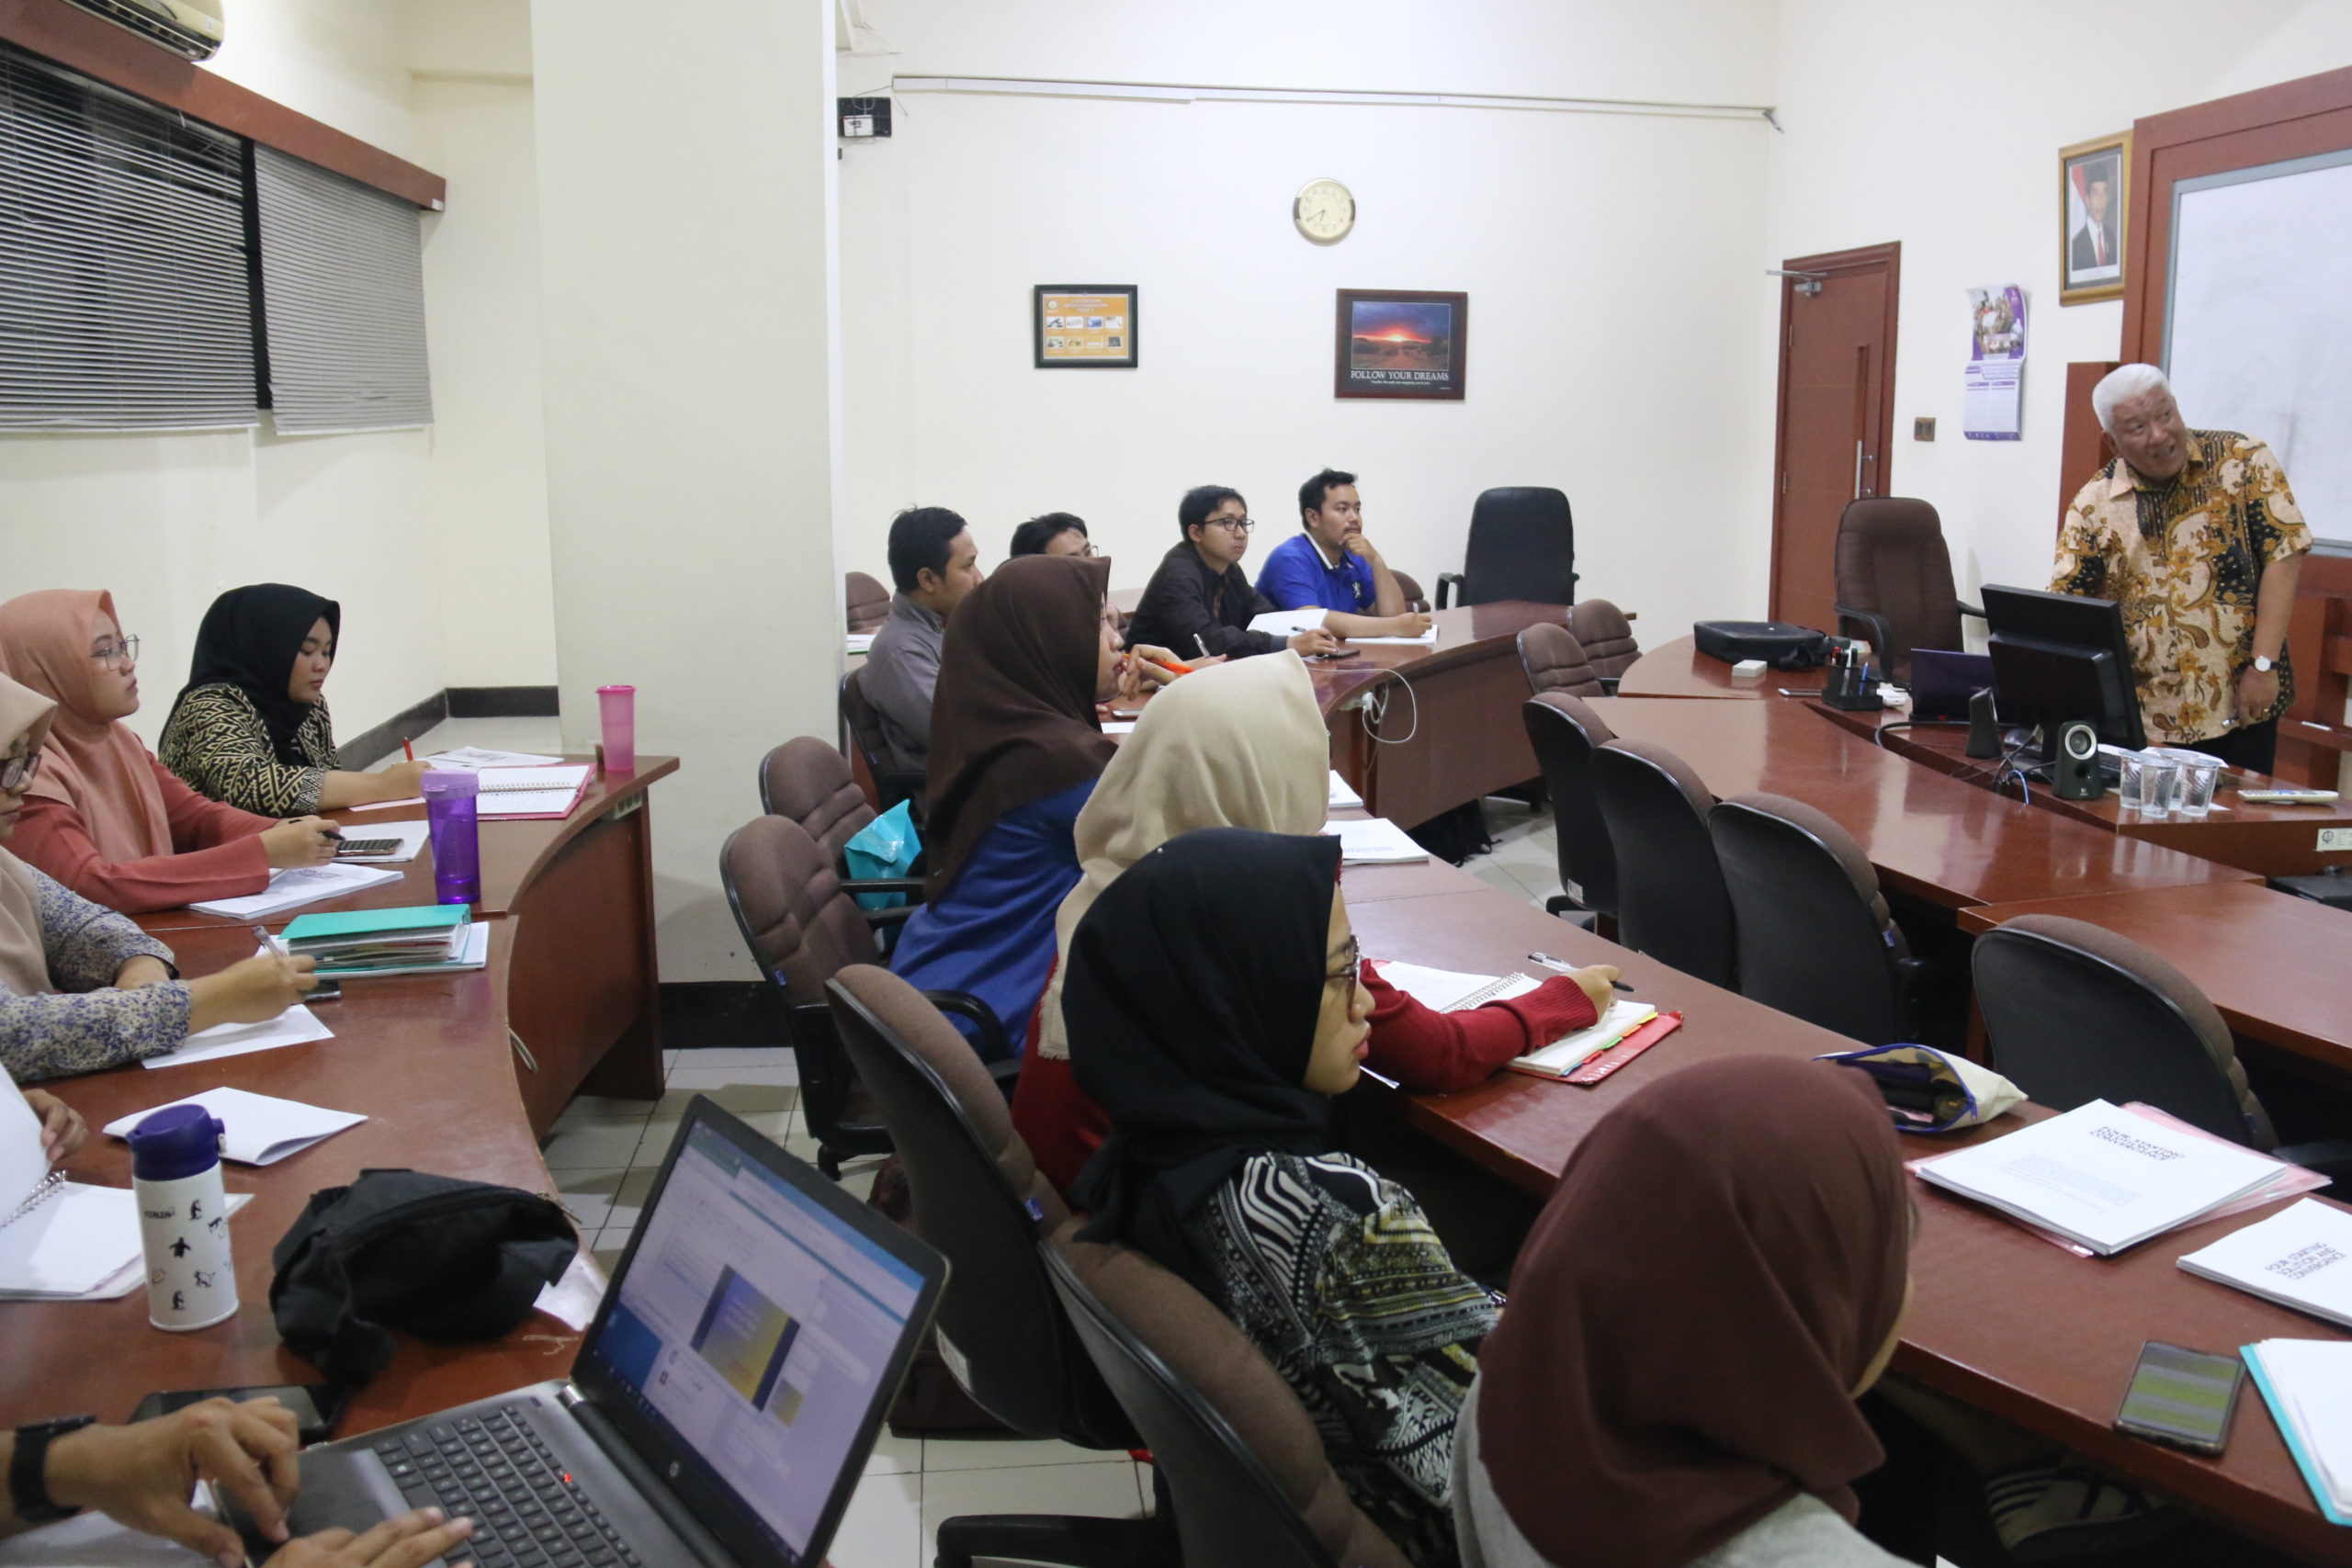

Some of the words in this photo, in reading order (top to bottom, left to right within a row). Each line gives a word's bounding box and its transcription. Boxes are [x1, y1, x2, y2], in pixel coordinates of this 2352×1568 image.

[1351, 370, 1385, 378] FOLLOW
[1388, 371, 1412, 379] YOUR
[1414, 371, 1449, 380] DREAMS
